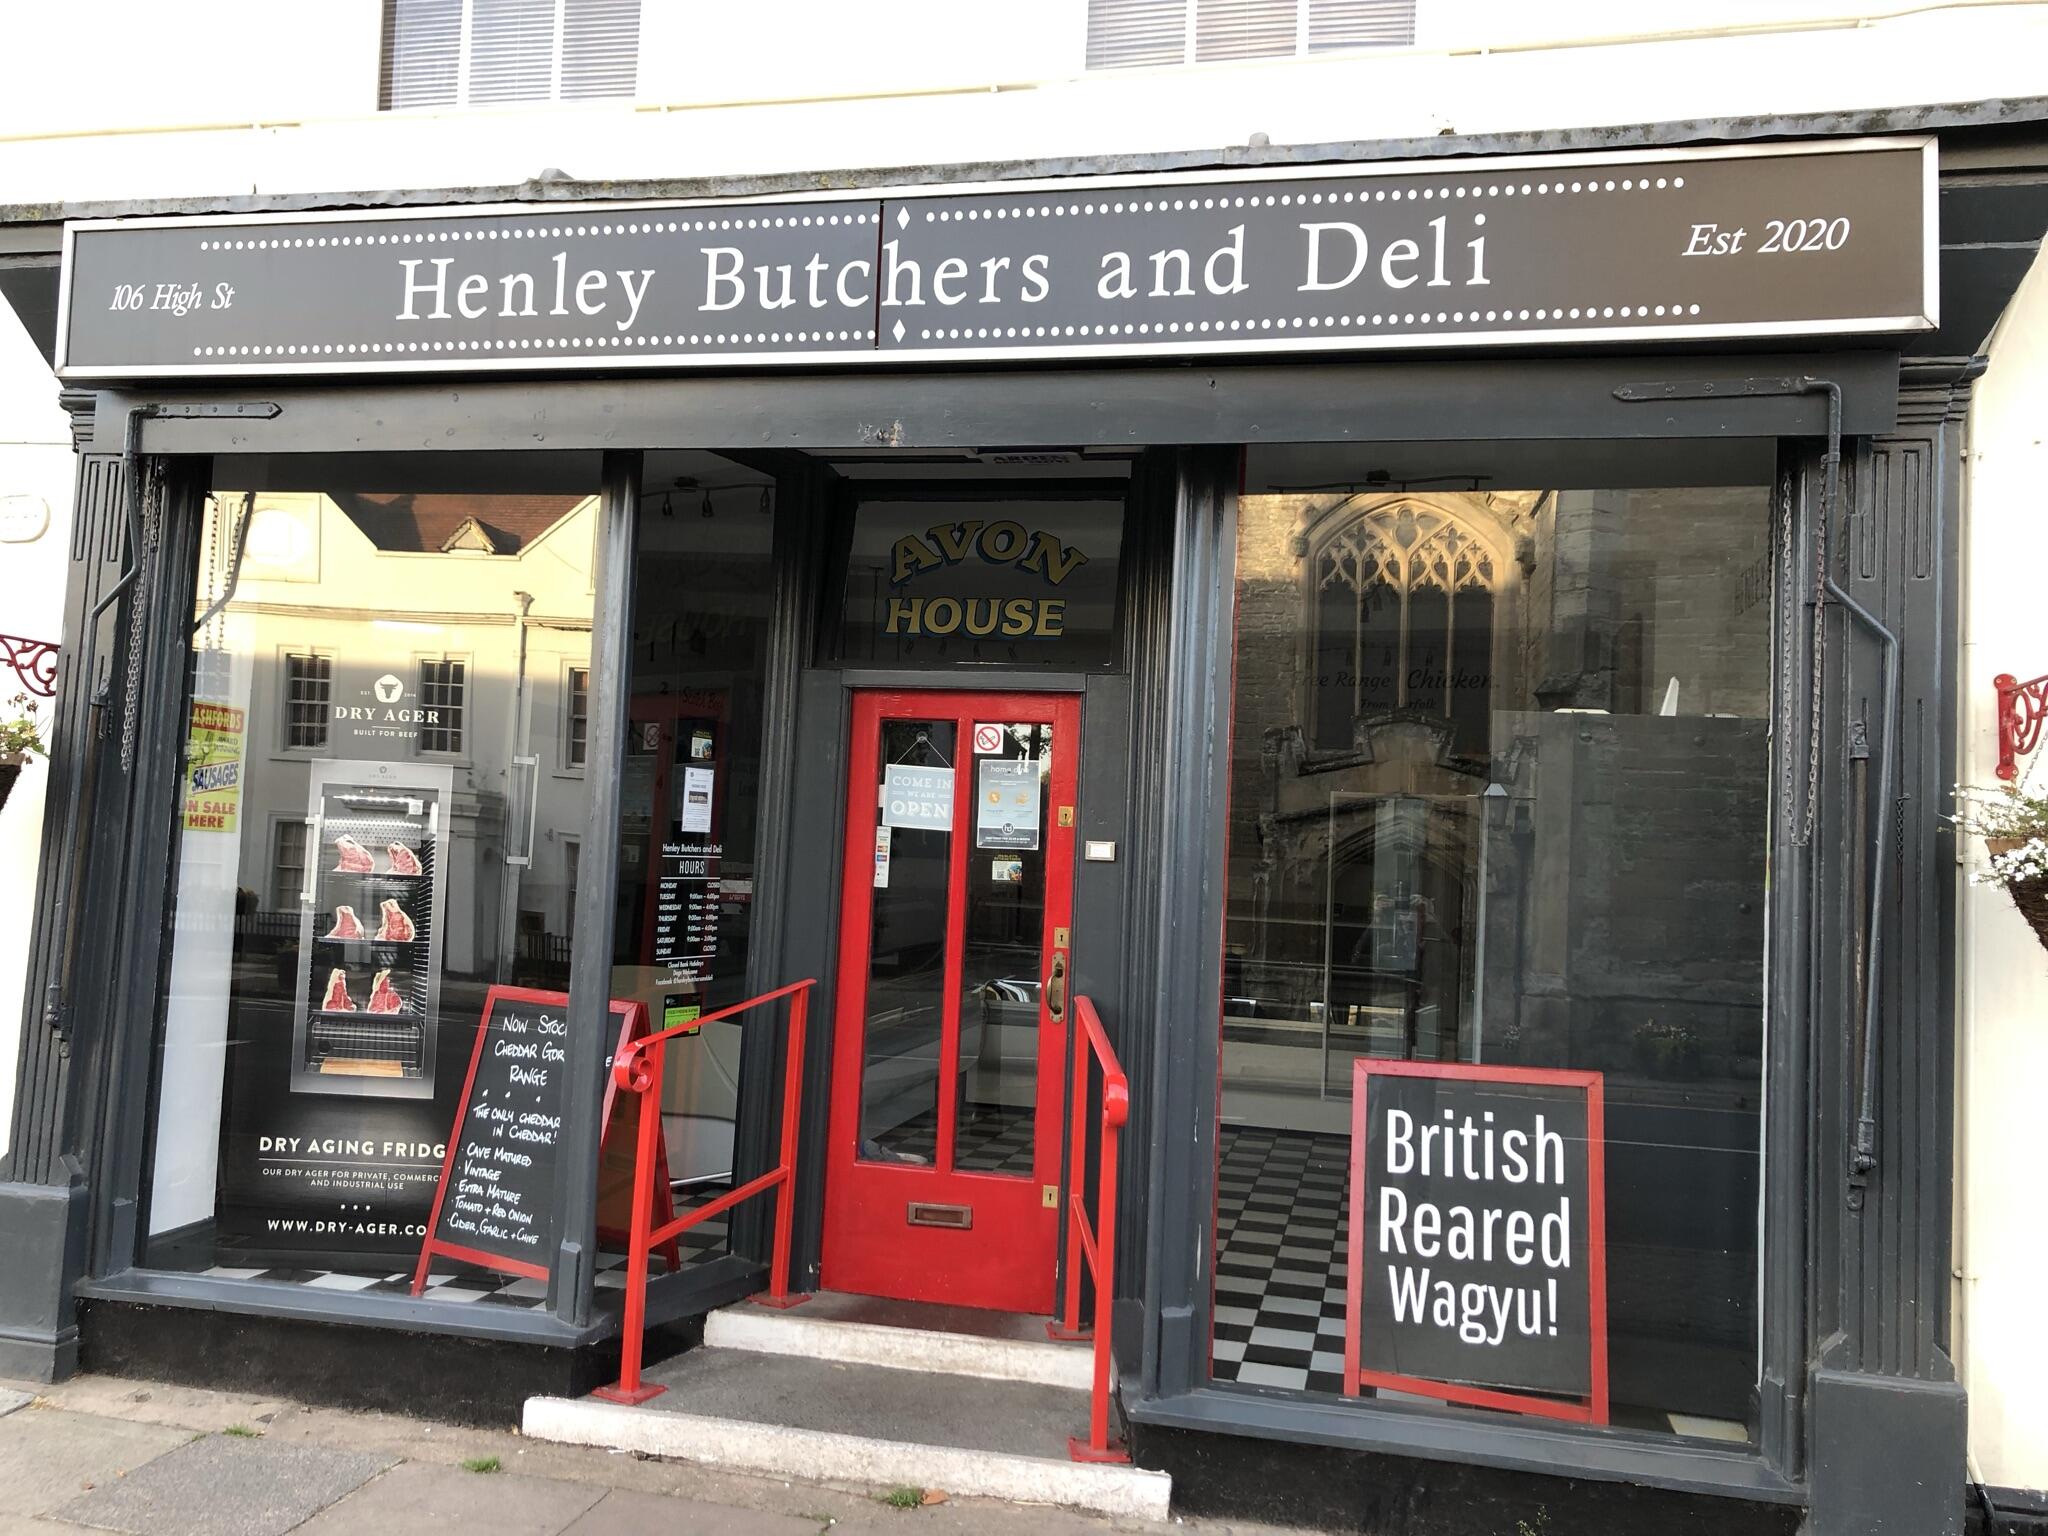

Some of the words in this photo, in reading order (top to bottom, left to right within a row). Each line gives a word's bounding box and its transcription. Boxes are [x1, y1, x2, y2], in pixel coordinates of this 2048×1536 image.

[1682, 223, 1742, 257] Est
[1757, 217, 1850, 254] 2020
[396, 252, 654, 330] Henley
[698, 239, 1050, 312] Butchers
[1097, 224, 1249, 299] and
[1297, 213, 1491, 292] Deli
[108, 284, 146, 310] 106
[150, 282, 202, 317] High
[210, 282, 236, 310] St
[890, 520, 1090, 587] AVON
[883, 597, 1067, 638] HOUSE
[192, 708, 241, 730] ASHFORDS
[335, 706, 376, 721] DRY
[383, 709, 439, 724] AGER
[353, 729, 376, 737] BUILT
[192, 763, 239, 793] SAUSAGES
[892, 776, 932, 788] COME
[936, 778, 952, 789] IN
[203, 801, 236, 815] SALE
[891, 800, 949, 819] OPEN
[188, 815, 224, 828] HERE
[662, 843, 680, 854] Henley
[681, 843, 702, 853] Butchers
[702, 844, 712, 853] and
[712, 844, 723, 853] Deli
[679, 860, 705, 874] HOURS
[259, 1136, 301, 1153] DRY
[307, 1138, 375, 1156] AGING
[382, 1142, 446, 1159] FRIDG
[1386, 1108, 1565, 1185] British
[262, 1168, 282, 1177] OUR
[284, 1169, 303, 1178] DRY
[304, 1170, 329, 1179] AGER
[331, 1170, 350, 1179] FOR
[352, 1171, 391, 1182] PRIVATE,
[310, 1179, 330, 1187] AND
[332, 1180, 385, 1190] INDUSTRIAL
[387, 1182, 404, 1190] USE
[267, 1219, 427, 1236] WWW.DRY-AGER.CO
[1379, 1186, 1571, 1268] Reared
[1387, 1264, 1558, 1346] Wagyu!
